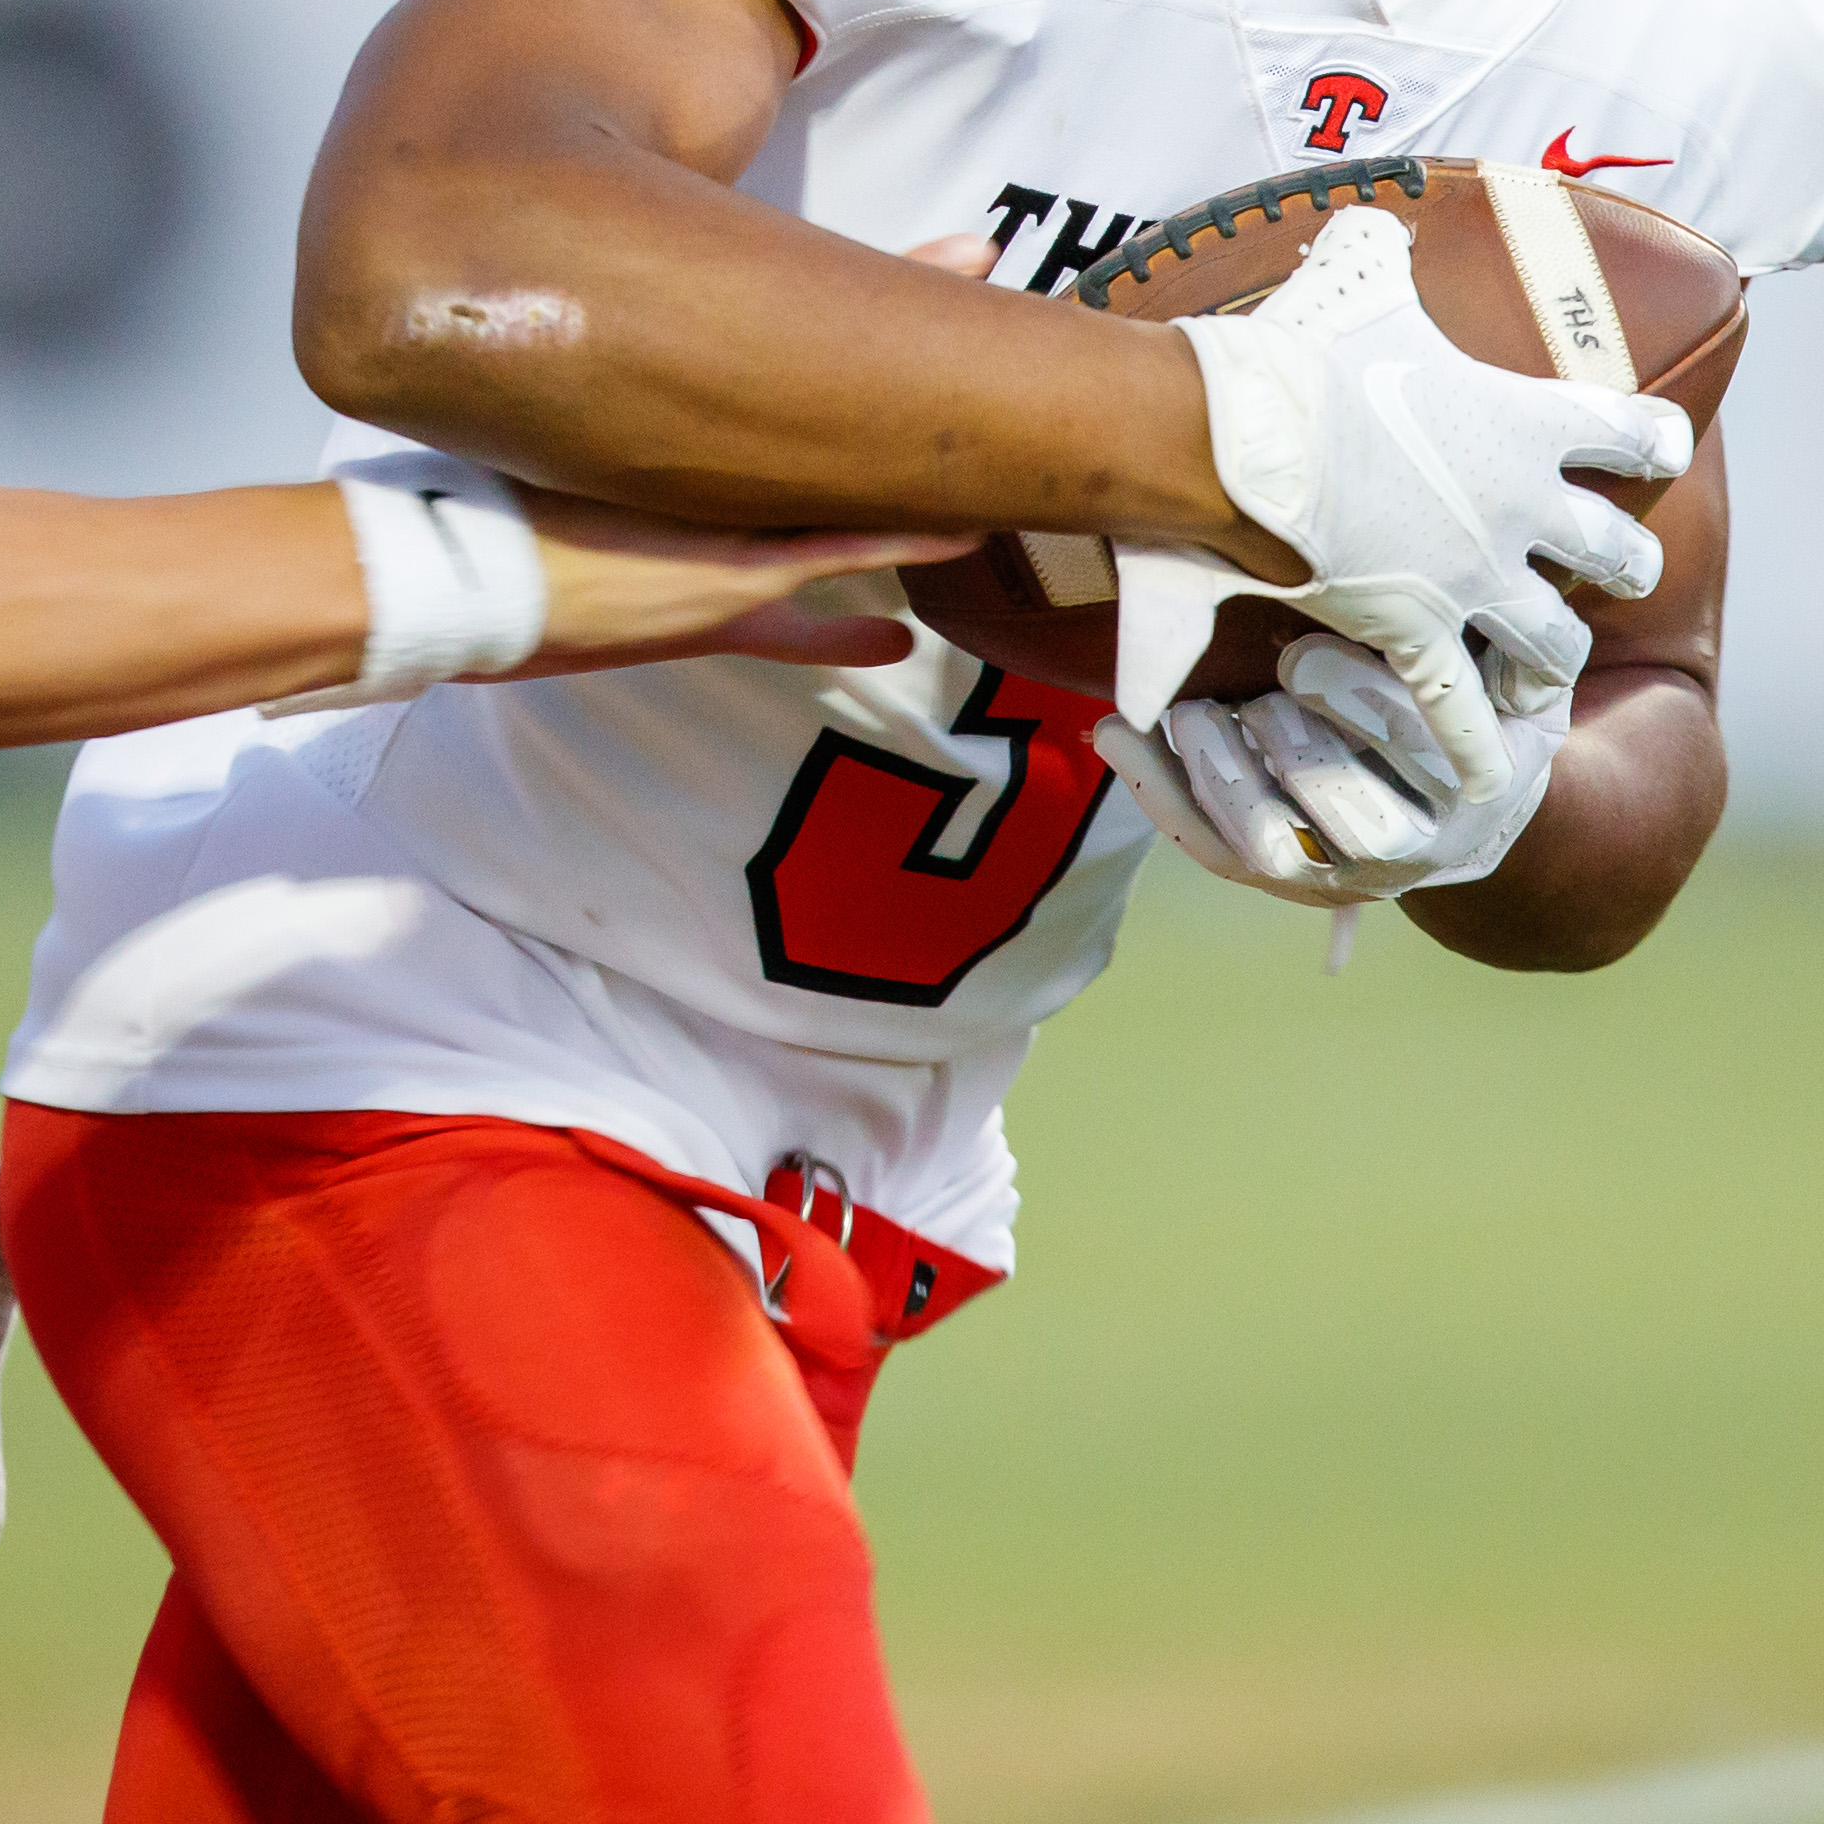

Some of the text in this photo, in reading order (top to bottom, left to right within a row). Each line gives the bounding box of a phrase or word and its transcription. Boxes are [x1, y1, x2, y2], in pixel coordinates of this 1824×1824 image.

[1299, 70, 1389, 155] T
[986, 182, 1162, 299] TH
[1557, 286, 1600, 349] THS
